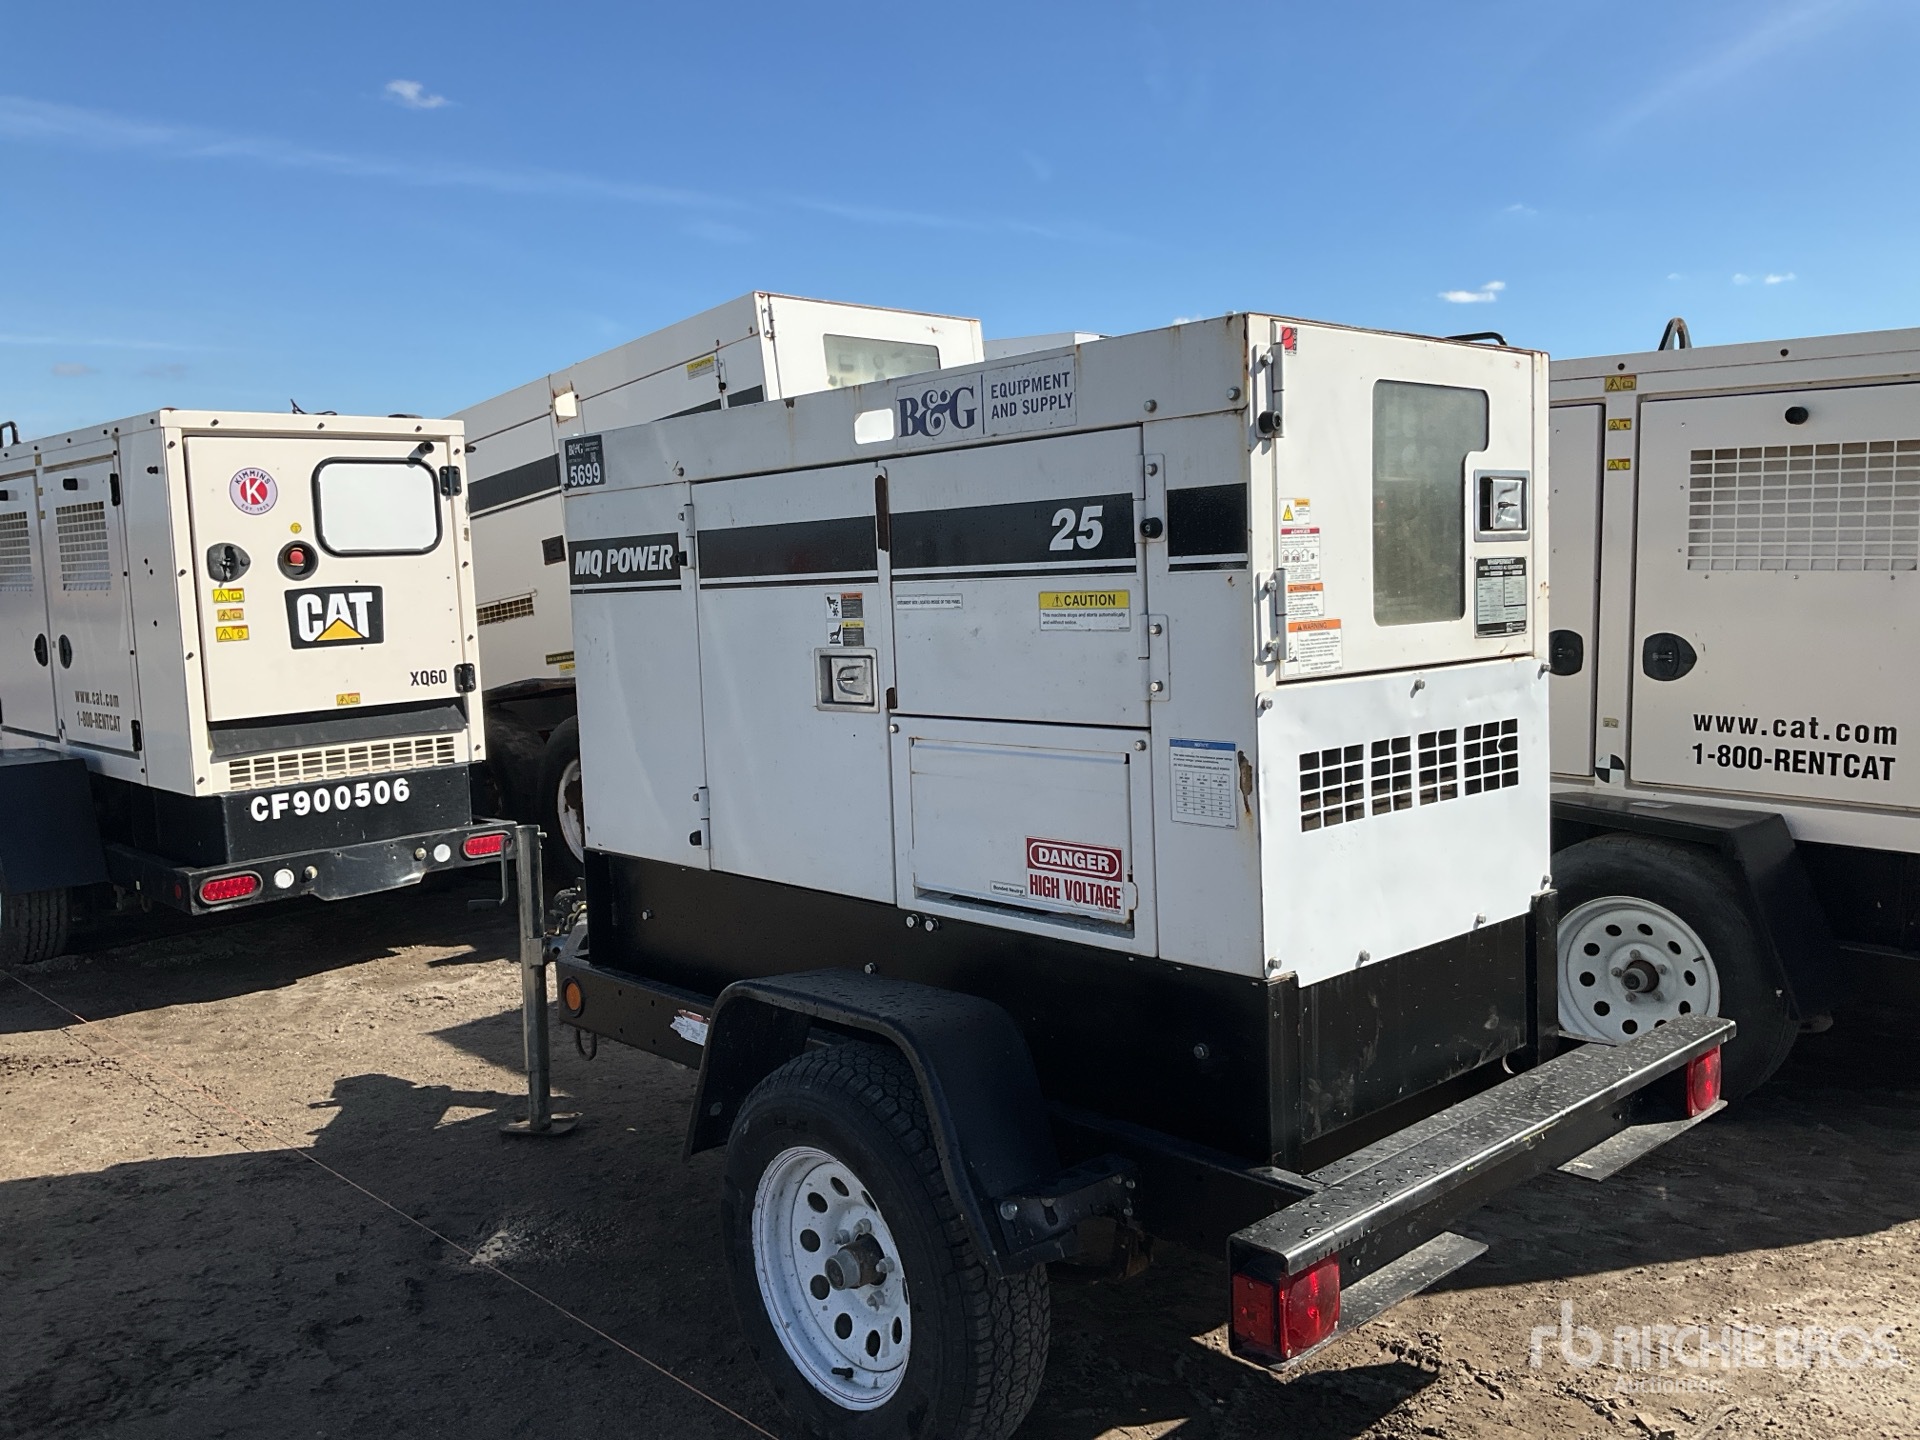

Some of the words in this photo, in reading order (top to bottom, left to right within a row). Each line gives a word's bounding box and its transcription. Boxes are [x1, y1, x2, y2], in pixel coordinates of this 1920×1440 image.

[991, 371, 1070, 399] EQUIPMENT
[897, 386, 977, 437] B&G
[991, 402, 1017, 419] AND
[1022, 392, 1073, 415] SUPPLY
[234, 470, 271, 485] KIMMINS
[570, 462, 600, 486] 5699
[245, 479, 264, 505] K
[1049, 505, 1103, 551] 25
[575, 549, 602, 578] MQ
[606, 544, 673, 573] POWER
[1064, 594, 1115, 606] CAUTION
[297, 592, 373, 642] CAT
[1303, 622, 1327, 631] WARNING
[410, 669, 447, 687] XQ60
[75, 690, 119, 708] www.cat.com
[77, 710, 120, 732] 1-800-RENTCAT
[1693, 714, 1897, 745] www.cat.com
[1692, 743, 1896, 781] 1-800-RENTCAT
[251, 777, 410, 822] CF900506
[1038, 847, 1109, 872] DANGER
[1029, 874, 1060, 899] HIGH
[1064, 879, 1121, 910] VOLTAGE
